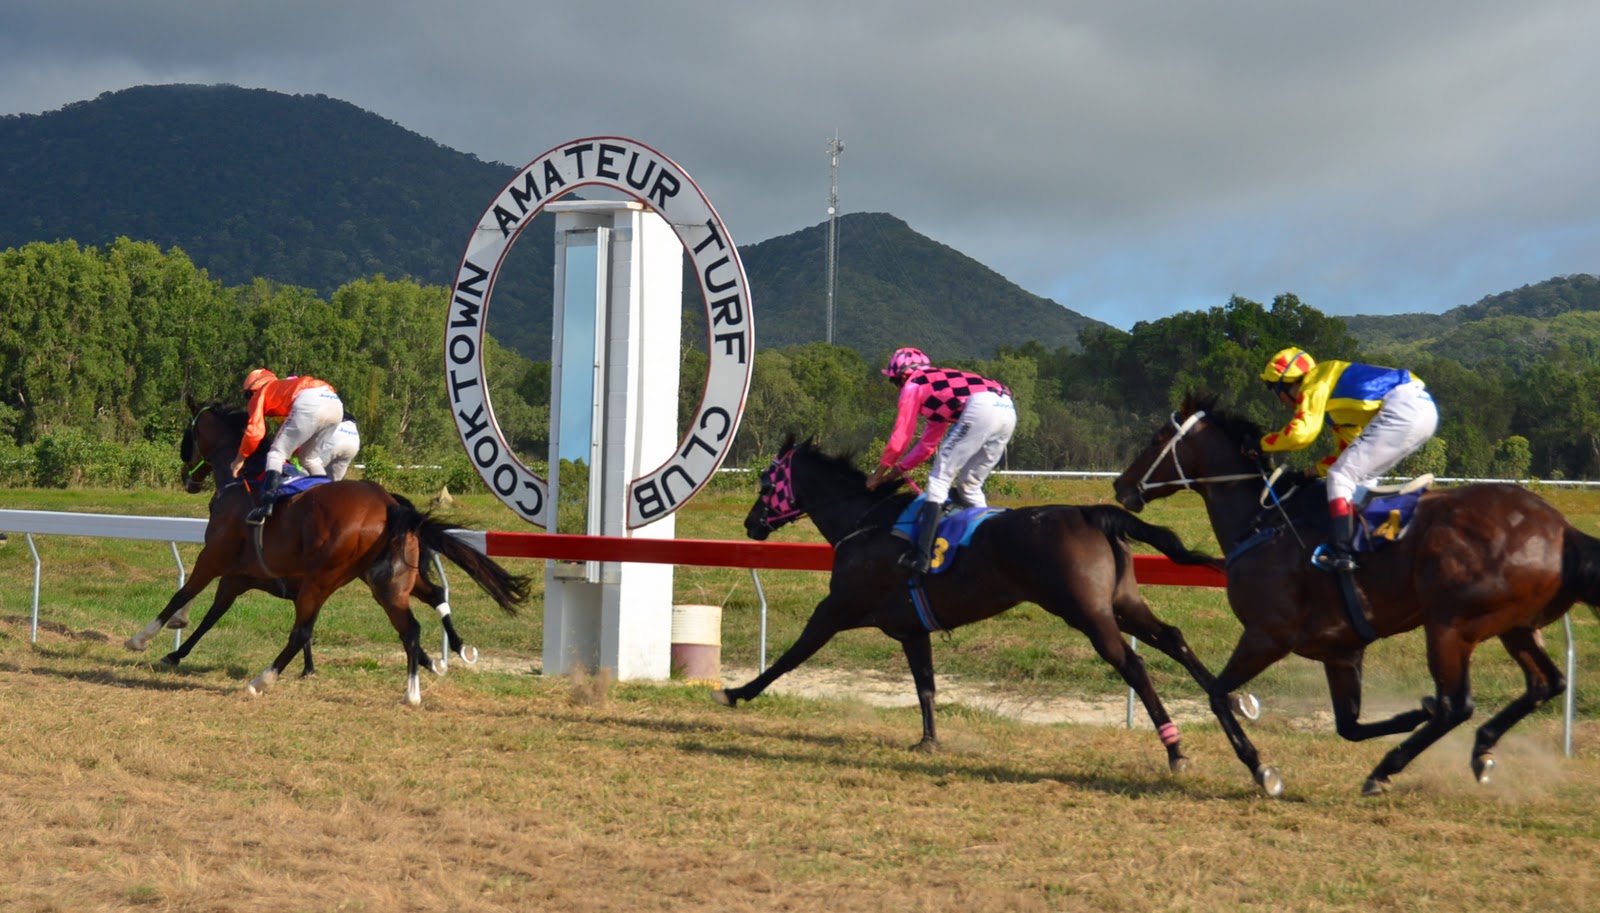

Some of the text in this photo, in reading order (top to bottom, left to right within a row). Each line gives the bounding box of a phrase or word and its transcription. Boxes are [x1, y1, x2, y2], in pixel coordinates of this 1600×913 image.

[449, 143, 746, 520] COOKTOWN AMATEUR TURF CLUB
[930, 537, 949, 569] 3
